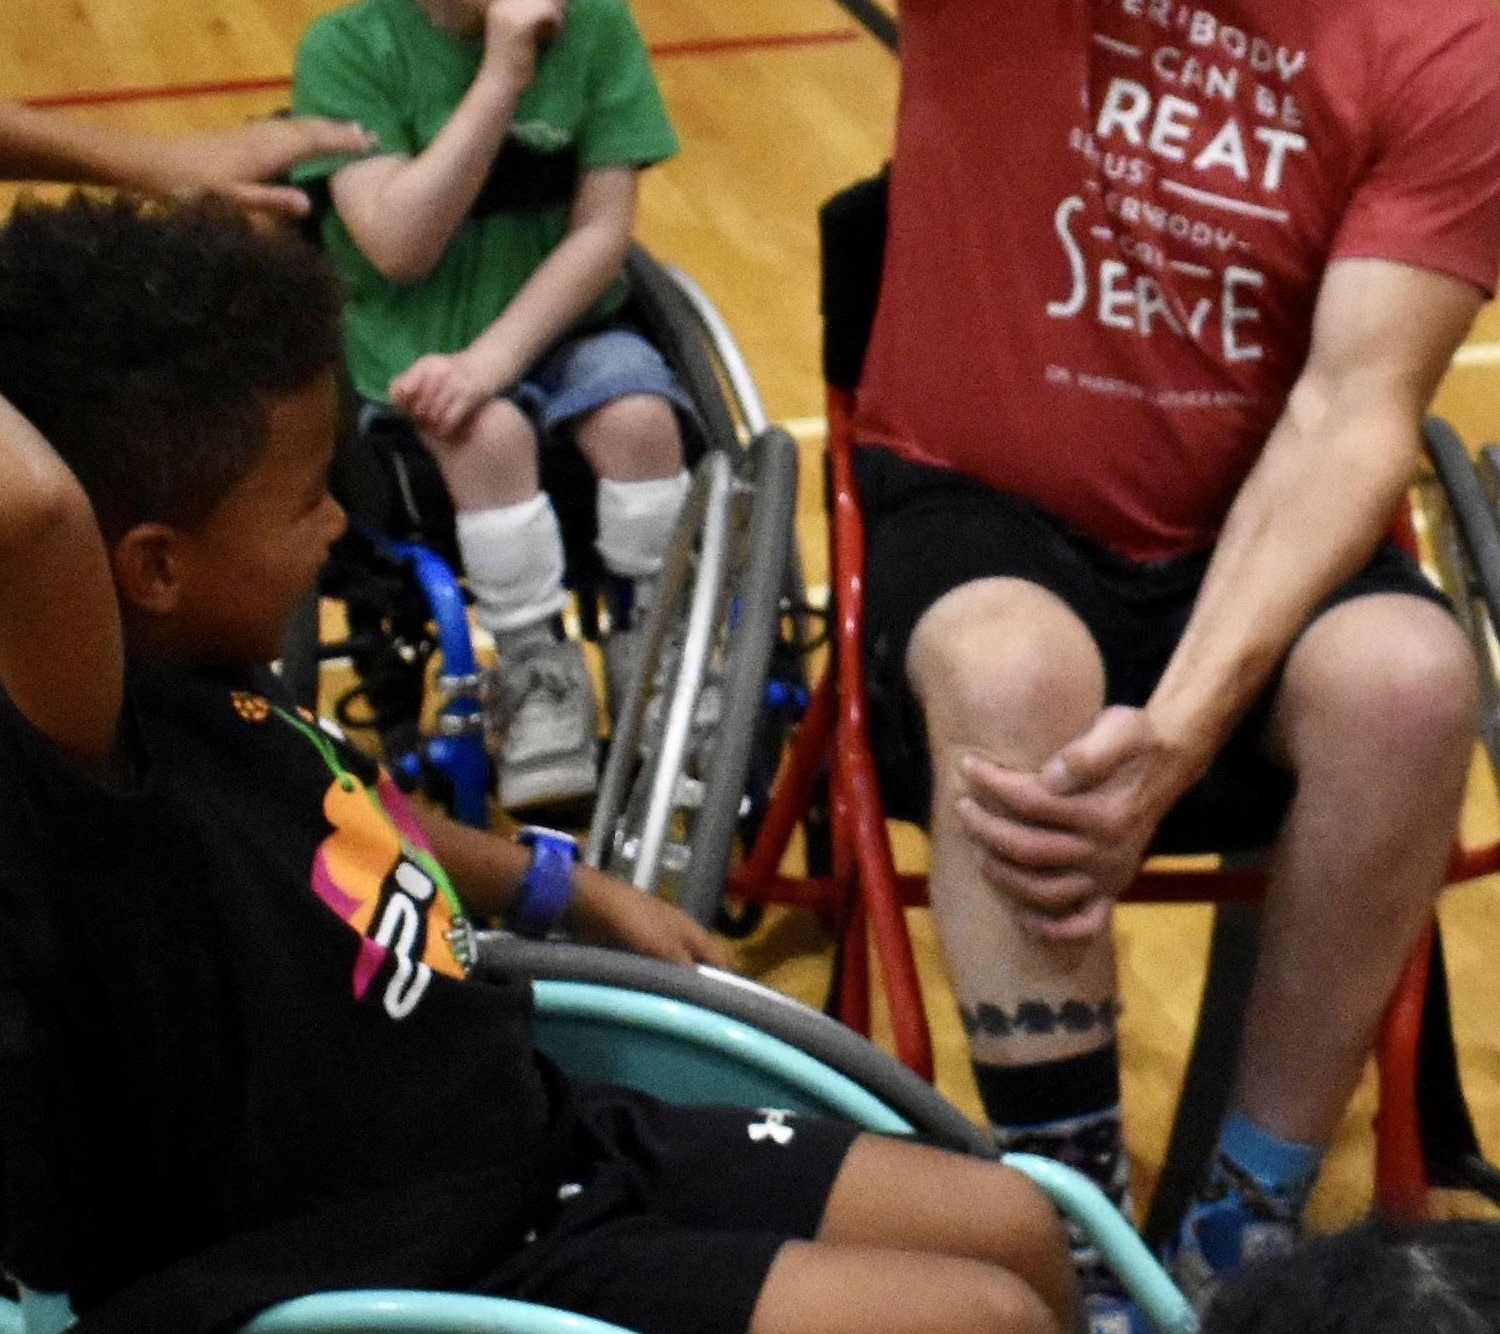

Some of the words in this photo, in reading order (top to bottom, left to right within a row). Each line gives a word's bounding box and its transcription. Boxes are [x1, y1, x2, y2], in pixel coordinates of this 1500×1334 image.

[1153, 45, 1239, 101] CAN
[1096, 75, 1308, 191] REAT
[1045, 195, 1267, 360] SERVE
